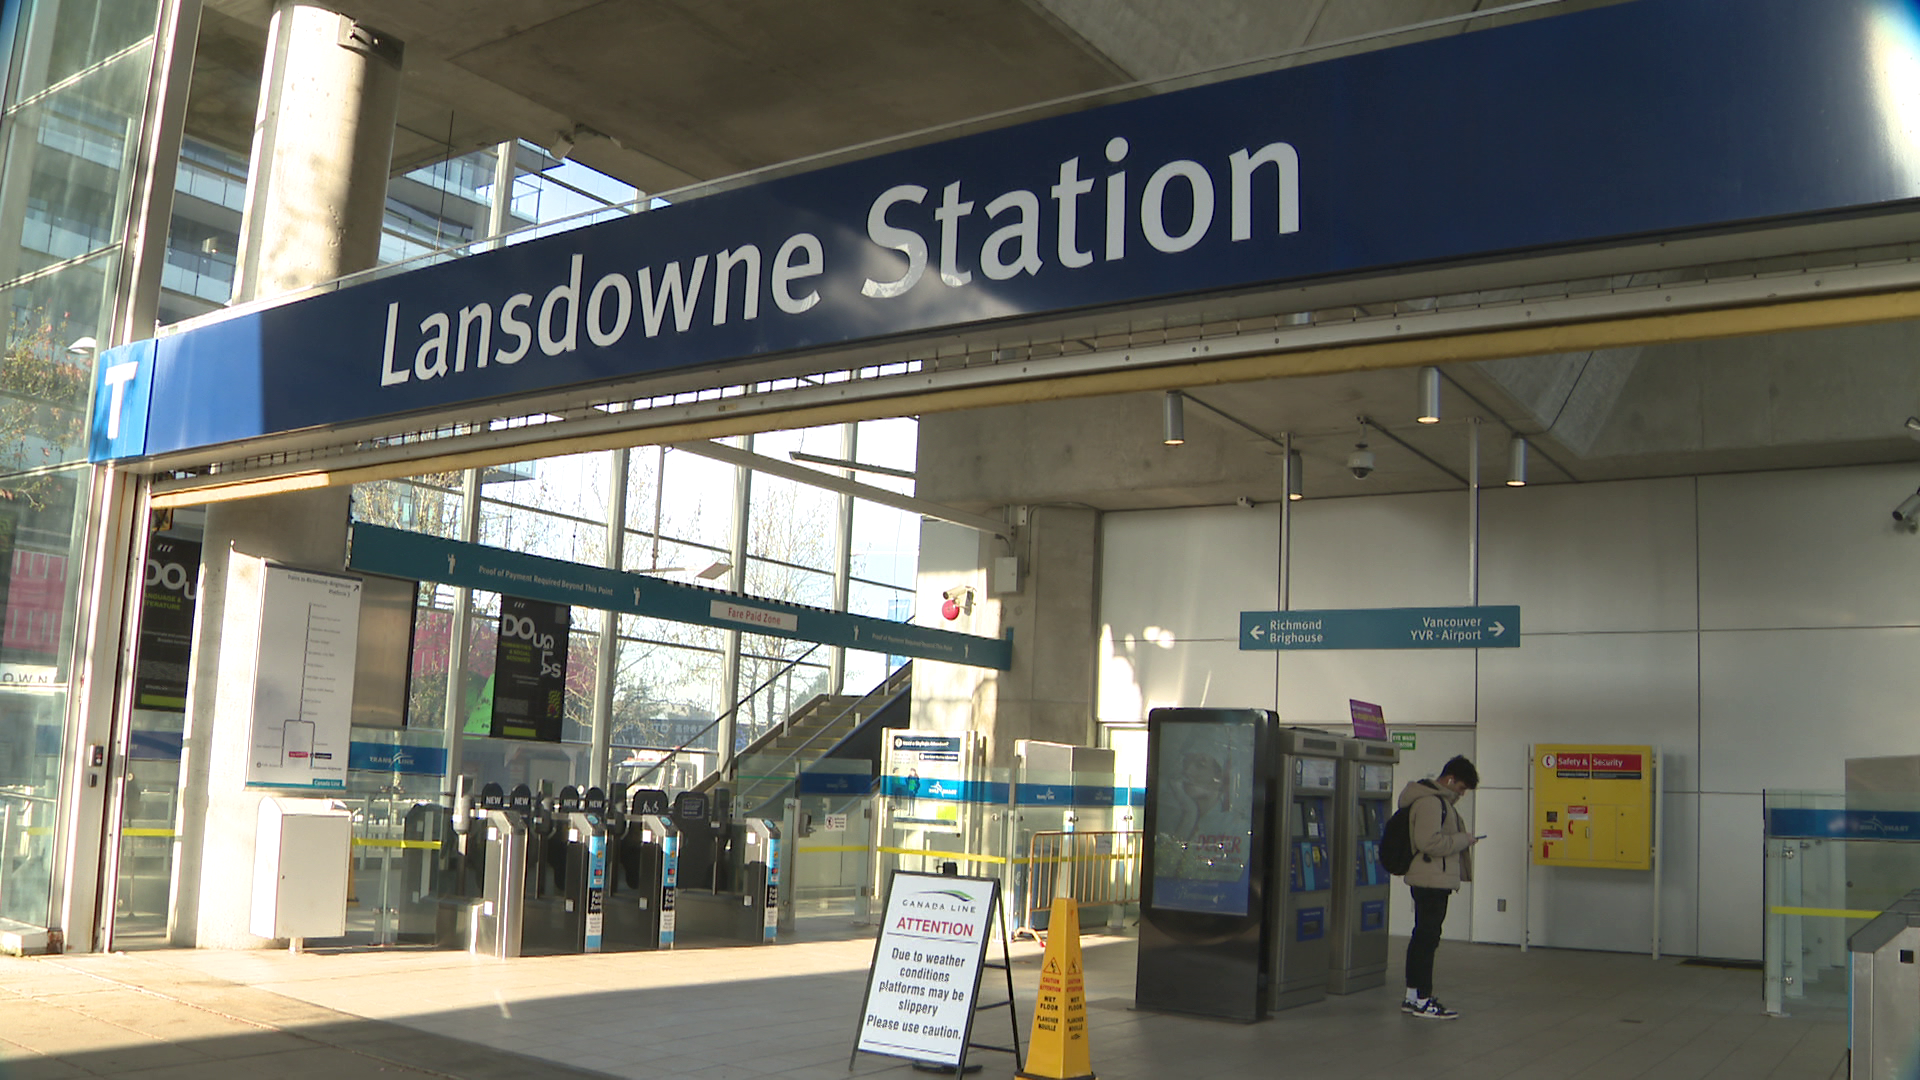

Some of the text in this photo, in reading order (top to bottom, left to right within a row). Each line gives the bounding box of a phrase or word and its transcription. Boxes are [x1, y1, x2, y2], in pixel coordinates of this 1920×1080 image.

[379, 137, 1301, 387] Lansdowne Station
[105, 361, 138, 440] T
[479, 565, 496, 575] Proof
[505, 570, 532, 582] Payment
[534, 575, 560, 586] Required
[561, 580, 584, 591] Beyond
[585, 583, 597, 593] This
[598, 585, 614, 596] Point
[728, 607, 781, 625] Fare Paid Zone
[1422, 616, 1482, 628] Vancouver
[1270, 619, 1322, 630] Richmond
[1270, 632, 1323, 645] Brighouse
[1410, 630, 1434, 640] YVR
[1441, 629, 1482, 643] Airport
[1558, 758, 1580, 767] Safety
[1593, 758, 1624, 767] Security
[486, 796, 501, 805] NEW
[514, 797, 528, 805] NEW
[564, 799, 578, 807] NEW
[589, 800, 603, 808] NEW
[902, 899, 976, 913] CANADA LINE
[896, 916, 974, 937] ATTENTION
[892, 947, 966, 968] Due to weather
[900, 967, 950, 982] conditions
[1042, 976, 1060, 984] CAUTION
[878, 980, 965, 1002] platforms may be
[898, 999, 938, 1016] slippery
[1040, 1003, 1058, 1011] FLOOR
[866, 1014, 961, 1040] Please use caution.
